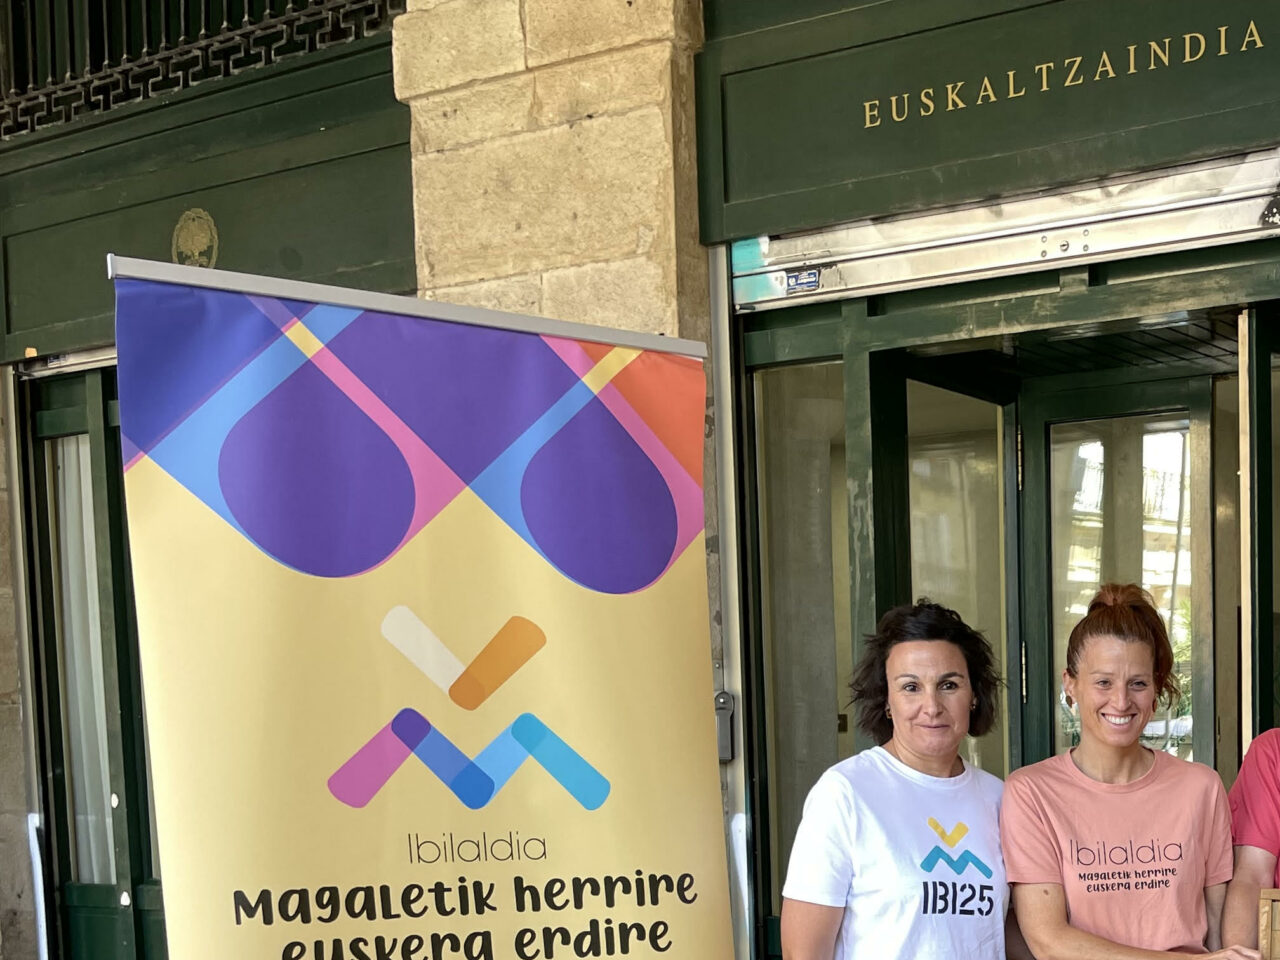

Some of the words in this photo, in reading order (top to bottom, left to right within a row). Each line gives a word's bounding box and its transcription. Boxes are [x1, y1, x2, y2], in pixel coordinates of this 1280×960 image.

[863, 20, 1264, 128] EUSKALTZAINDIA
[408, 831, 546, 864] Ibilaldia
[1070, 839, 1184, 866] Ibilaldia
[1078, 870, 1132, 881] Magaletik
[1134, 867, 1178, 879] herrire
[1086, 882, 1131, 893] euskera
[1134, 879, 1171, 890] erdire
[233, 875, 498, 926] Magaletik
[513, 869, 698, 913] herrire
[922, 881, 995, 917] IBI25
[514, 918, 673, 960] erdire
